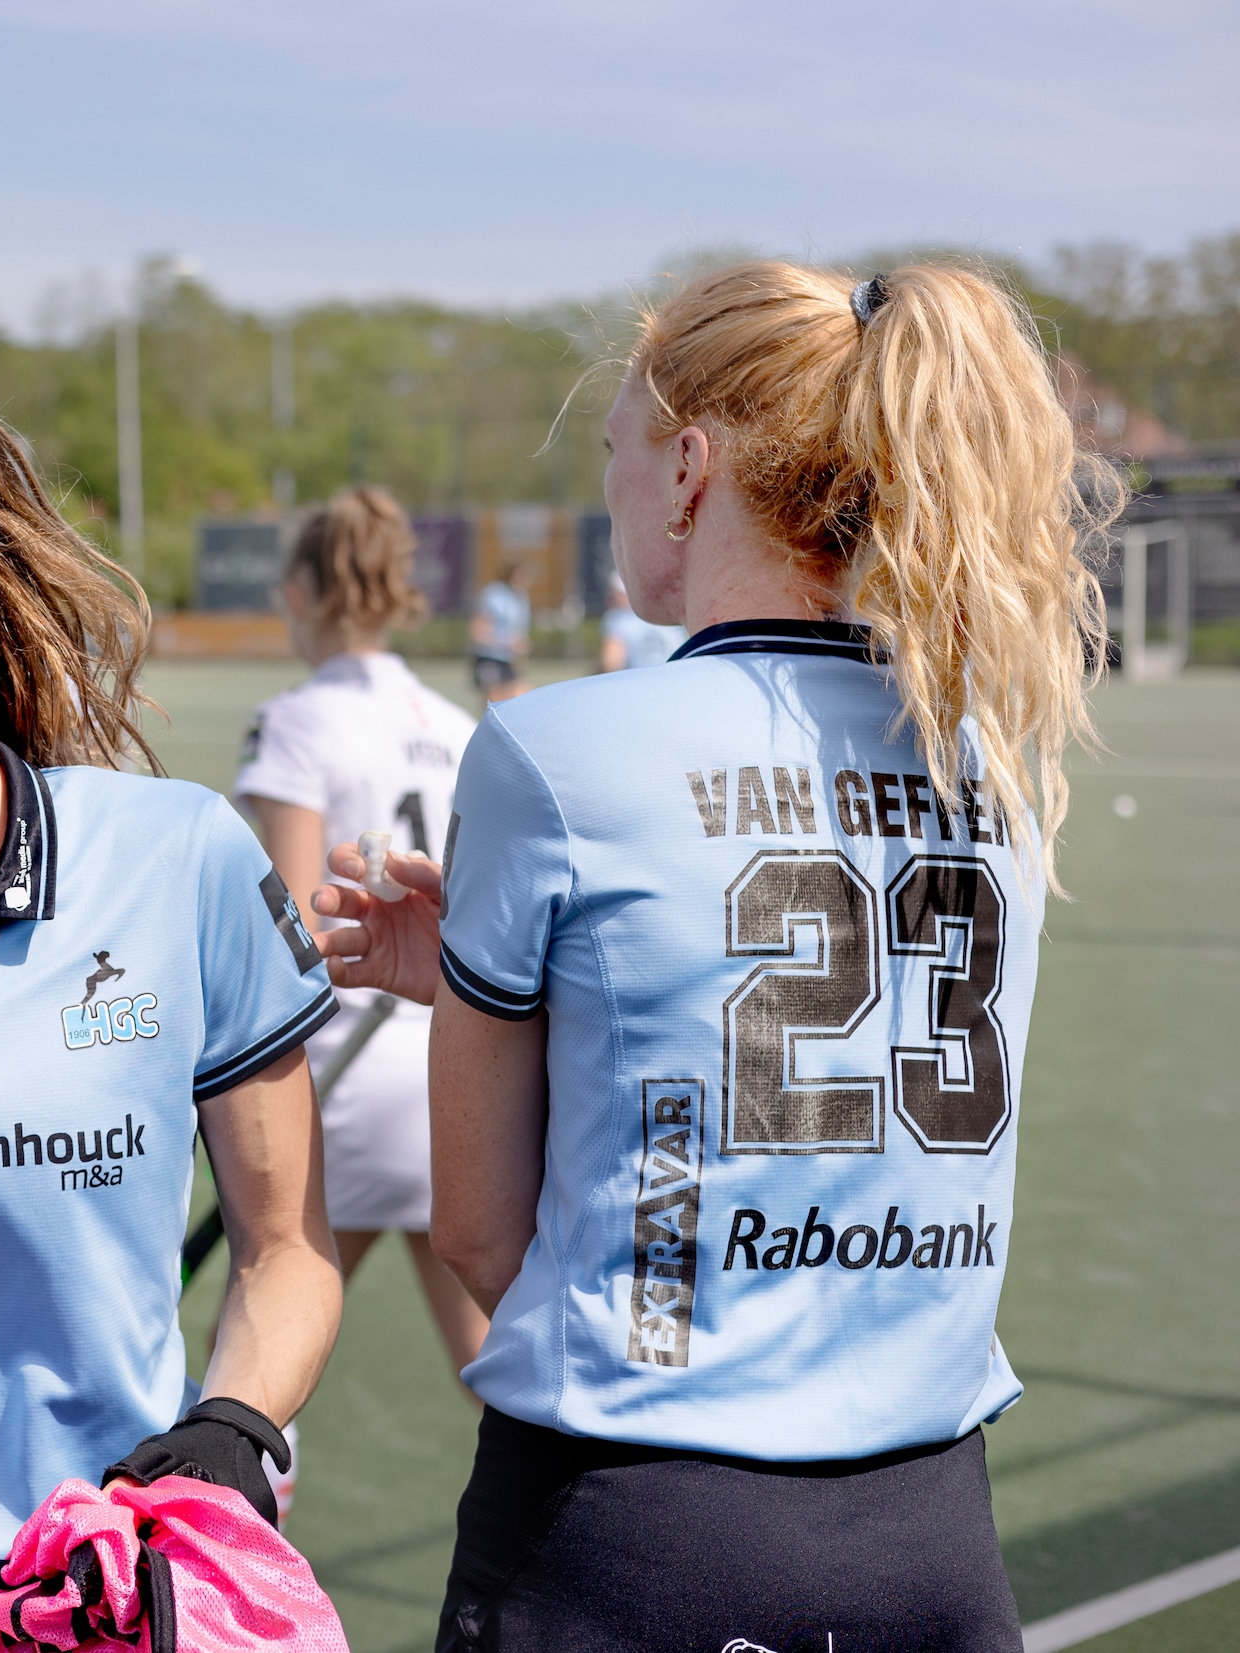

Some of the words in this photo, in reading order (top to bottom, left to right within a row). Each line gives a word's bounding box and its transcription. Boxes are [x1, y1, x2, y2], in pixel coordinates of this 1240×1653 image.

[685, 766, 817, 838] VAN
[61, 992, 160, 1051] HGC
[719, 848, 1013, 1156] 23
[68, 1029, 91, 1040] 1906
[61, 1165, 124, 1191] m&a
[722, 1204, 996, 1272] Rabobank
